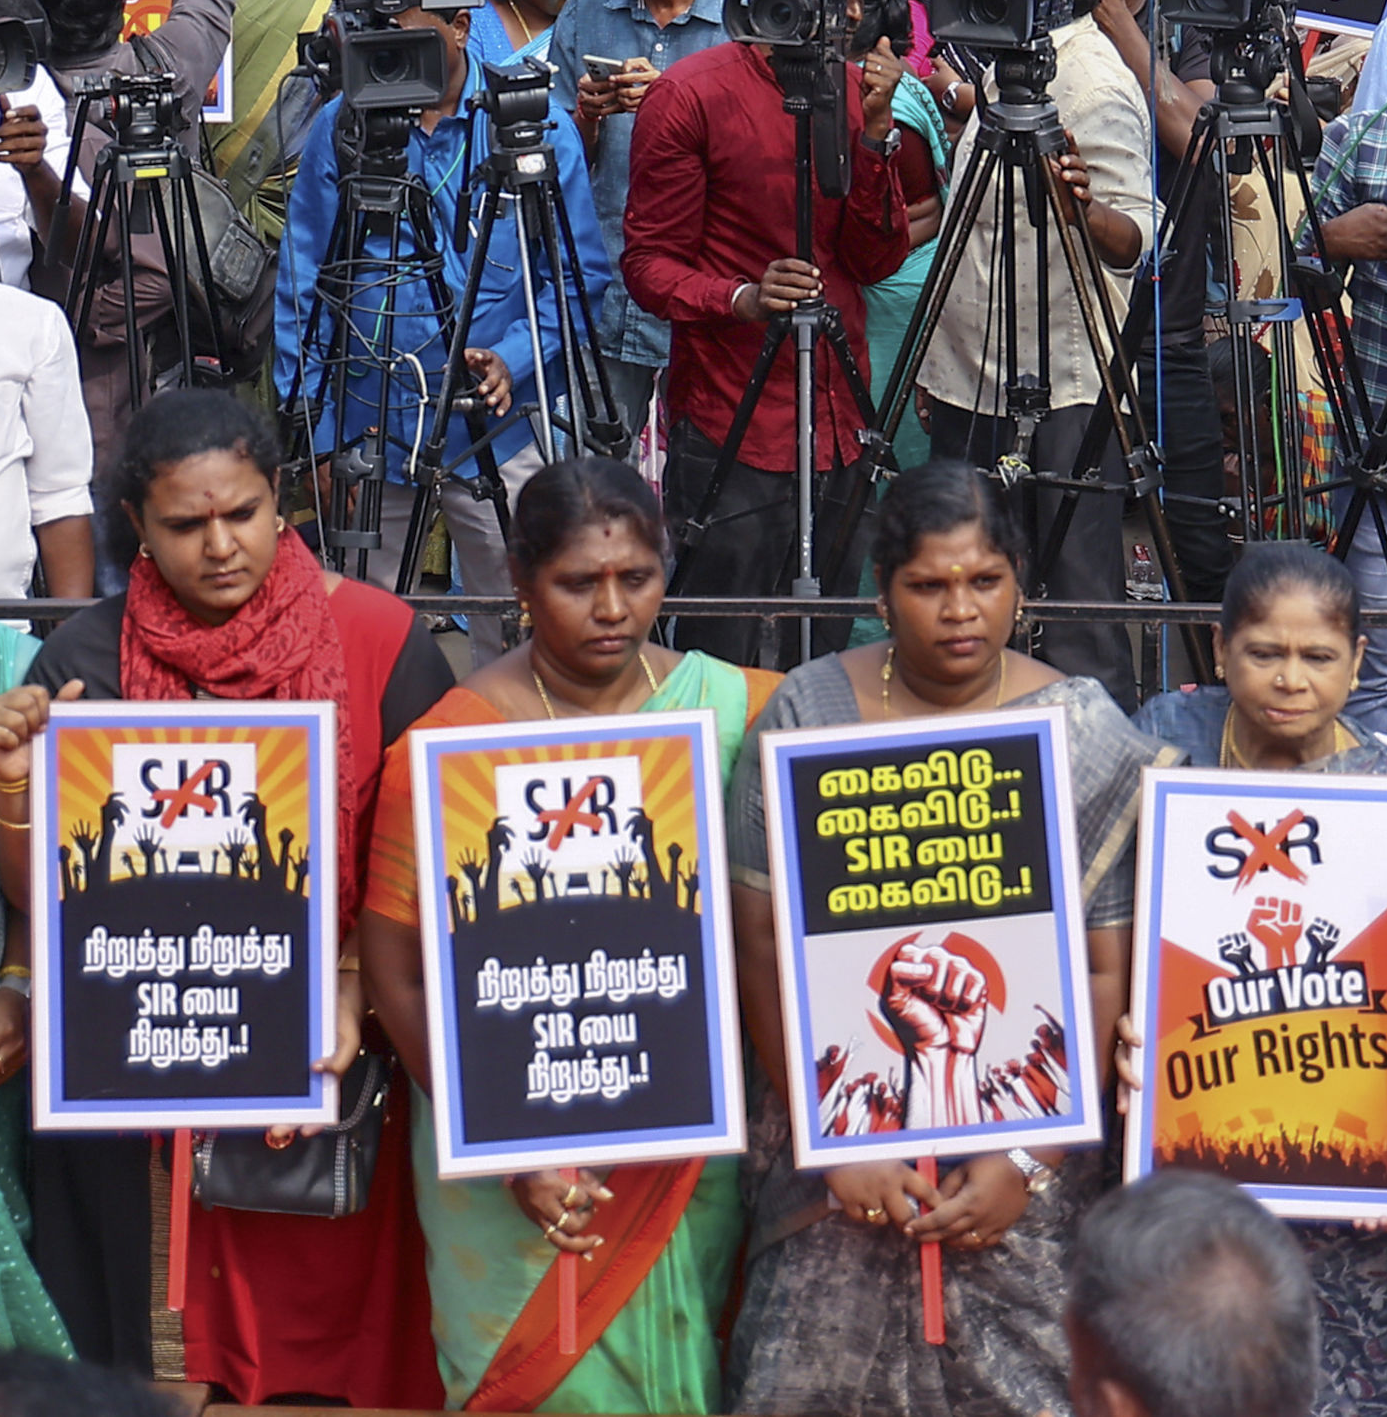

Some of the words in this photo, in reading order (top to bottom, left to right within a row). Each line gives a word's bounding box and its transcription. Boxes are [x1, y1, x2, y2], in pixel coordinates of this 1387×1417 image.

[818, 748, 1023, 798] கைவிடு...
[816, 788, 1022, 837] கைவிடு..!
[844, 834, 911, 873] SIR
[915, 832, 1003, 866] யை
[827, 864, 1033, 914] கைவிடு..!
[83, 924, 183, 976] நிறுத்து
[188, 924, 291, 976] நிறுத்து
[138, 982, 177, 1016] SIR
[182, 985, 239, 1016] யை
[475, 955, 579, 1011] நிறுத்து
[582, 948, 687, 1003] நிறுத்து
[1207, 975, 1274, 1020] Our
[1279, 965, 1366, 1009] Vote
[127, 1018, 249, 1067] நிறுத்து..!
[532, 1011, 574, 1049] SIR
[578, 1012, 637, 1046] யை
[526, 1049, 649, 1104] நிறுத்து..!
[1166, 1041, 1239, 1101] Our
